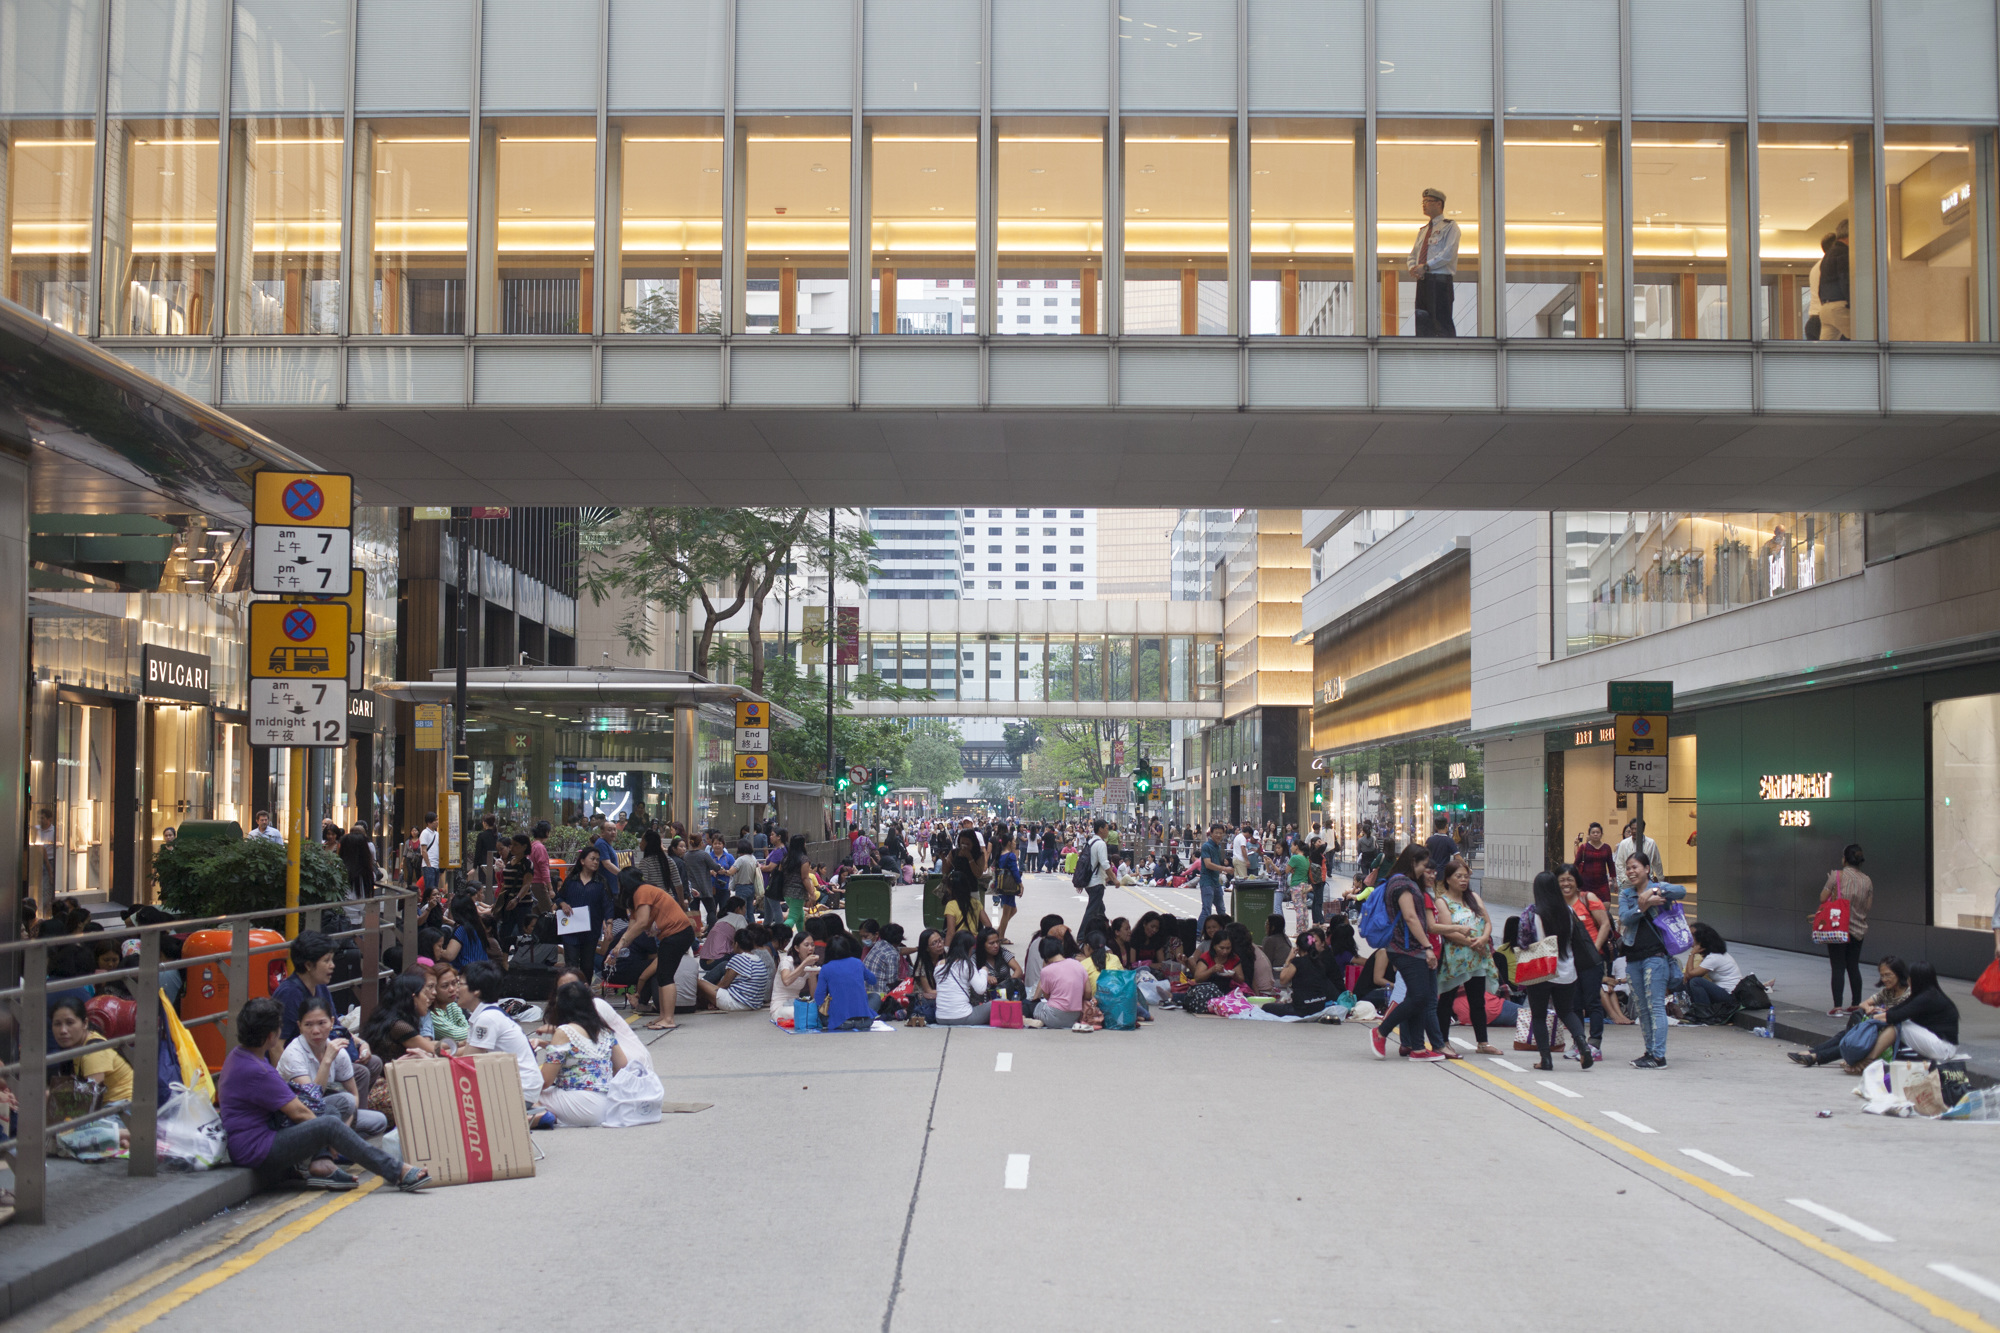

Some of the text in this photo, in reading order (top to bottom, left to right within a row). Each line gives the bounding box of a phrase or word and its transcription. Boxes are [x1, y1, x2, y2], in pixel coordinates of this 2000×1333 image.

[279, 530, 296, 538] am
[273, 541, 301, 553] 上午
[317, 533, 332, 554] 7
[278, 565, 295, 574] pm
[273, 576, 300, 588] 下午
[316, 568, 332, 589] 7
[149, 659, 208, 690] BVLGARI
[272, 682, 289, 690] am
[267, 692, 295, 705] 上午
[312, 684, 327, 705] 7
[349, 698, 373, 718] LGARI
[255, 717, 306, 728] midnight
[266, 729, 295, 742] 午夜
[312, 720, 341, 742] 12
[741, 740, 762, 749] 終止
[1629, 761, 1652, 771] End
[1624, 774, 1656, 788] 終止
[741, 792, 761, 801] 終止
[459, 1076, 484, 1162] JUMBO
